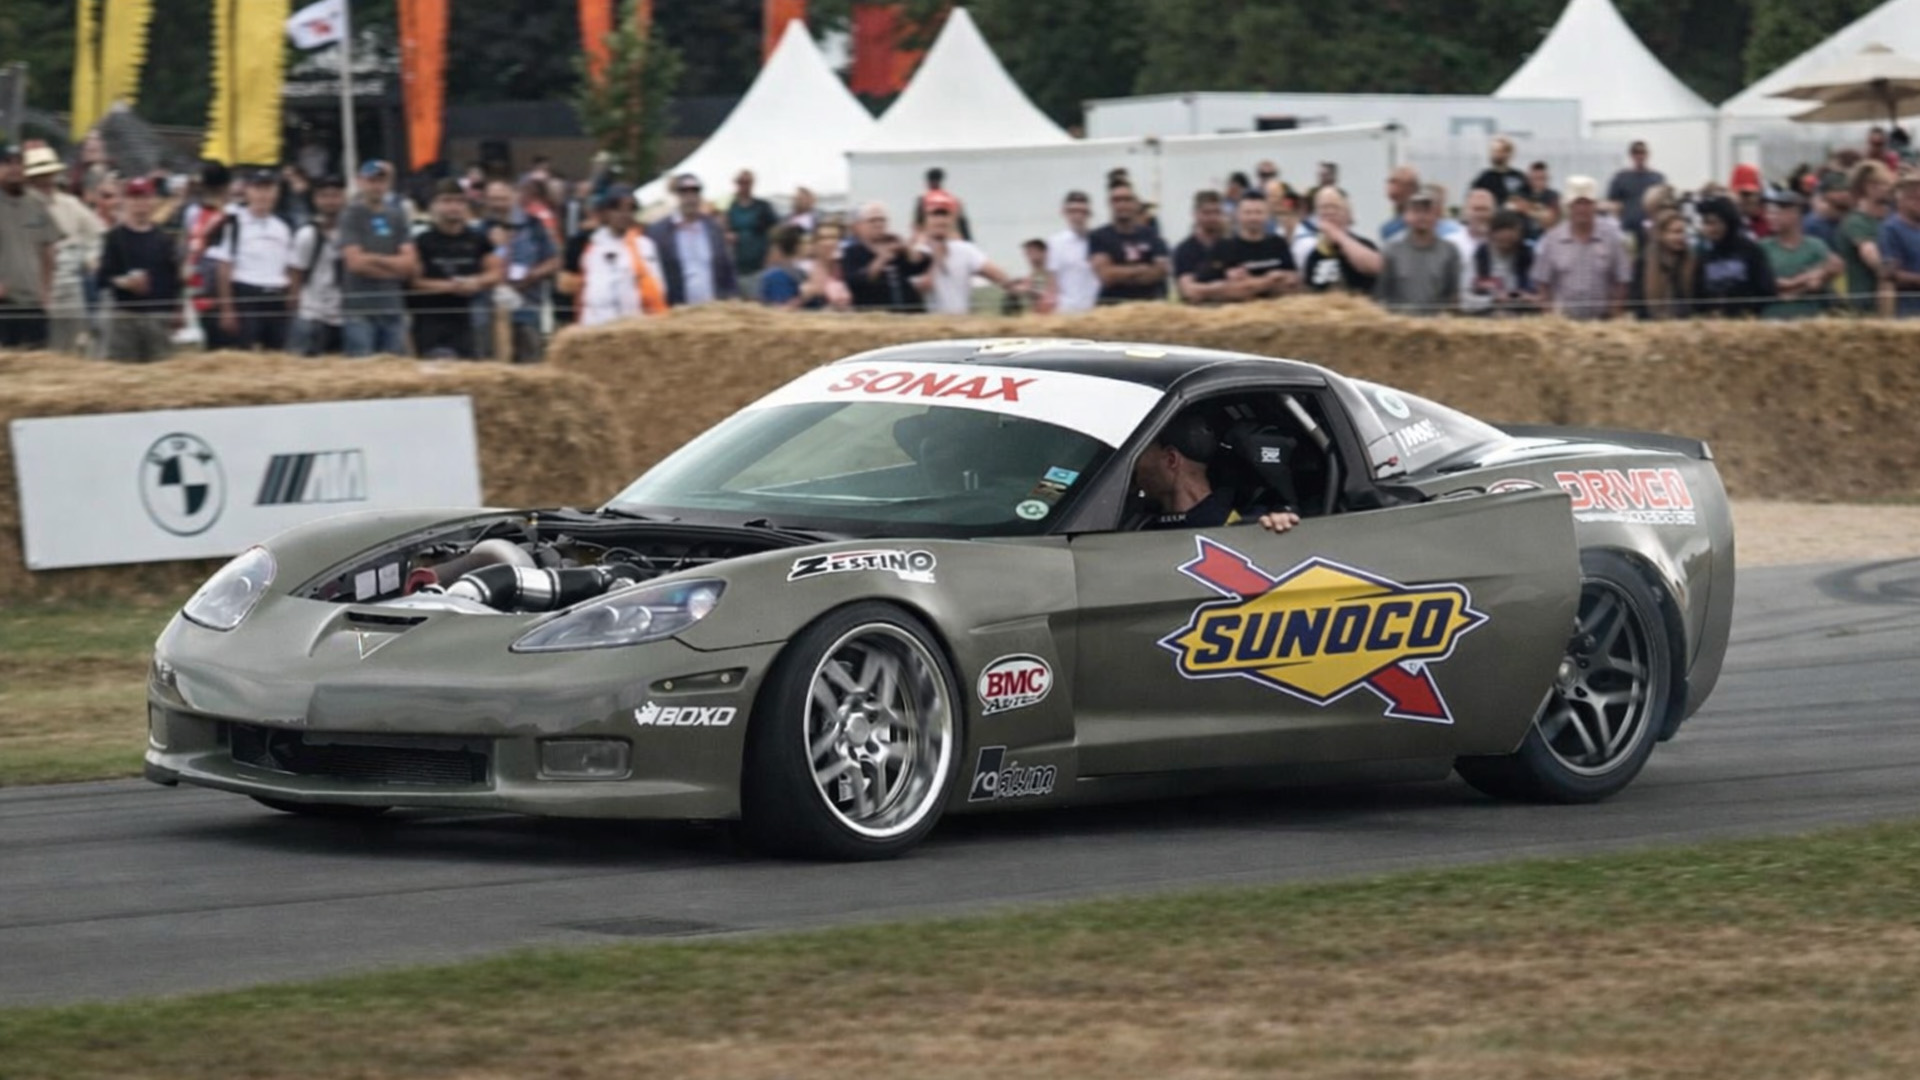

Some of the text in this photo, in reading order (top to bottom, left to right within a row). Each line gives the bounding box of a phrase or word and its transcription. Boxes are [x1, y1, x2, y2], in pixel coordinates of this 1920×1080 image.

[828, 369, 1036, 401] SONAX
[788, 550, 936, 581] ZESTINO
[1193, 598, 1455, 664] SUNOCO
[985, 667, 1045, 699] BMC
[655, 706, 737, 726] BOXO
